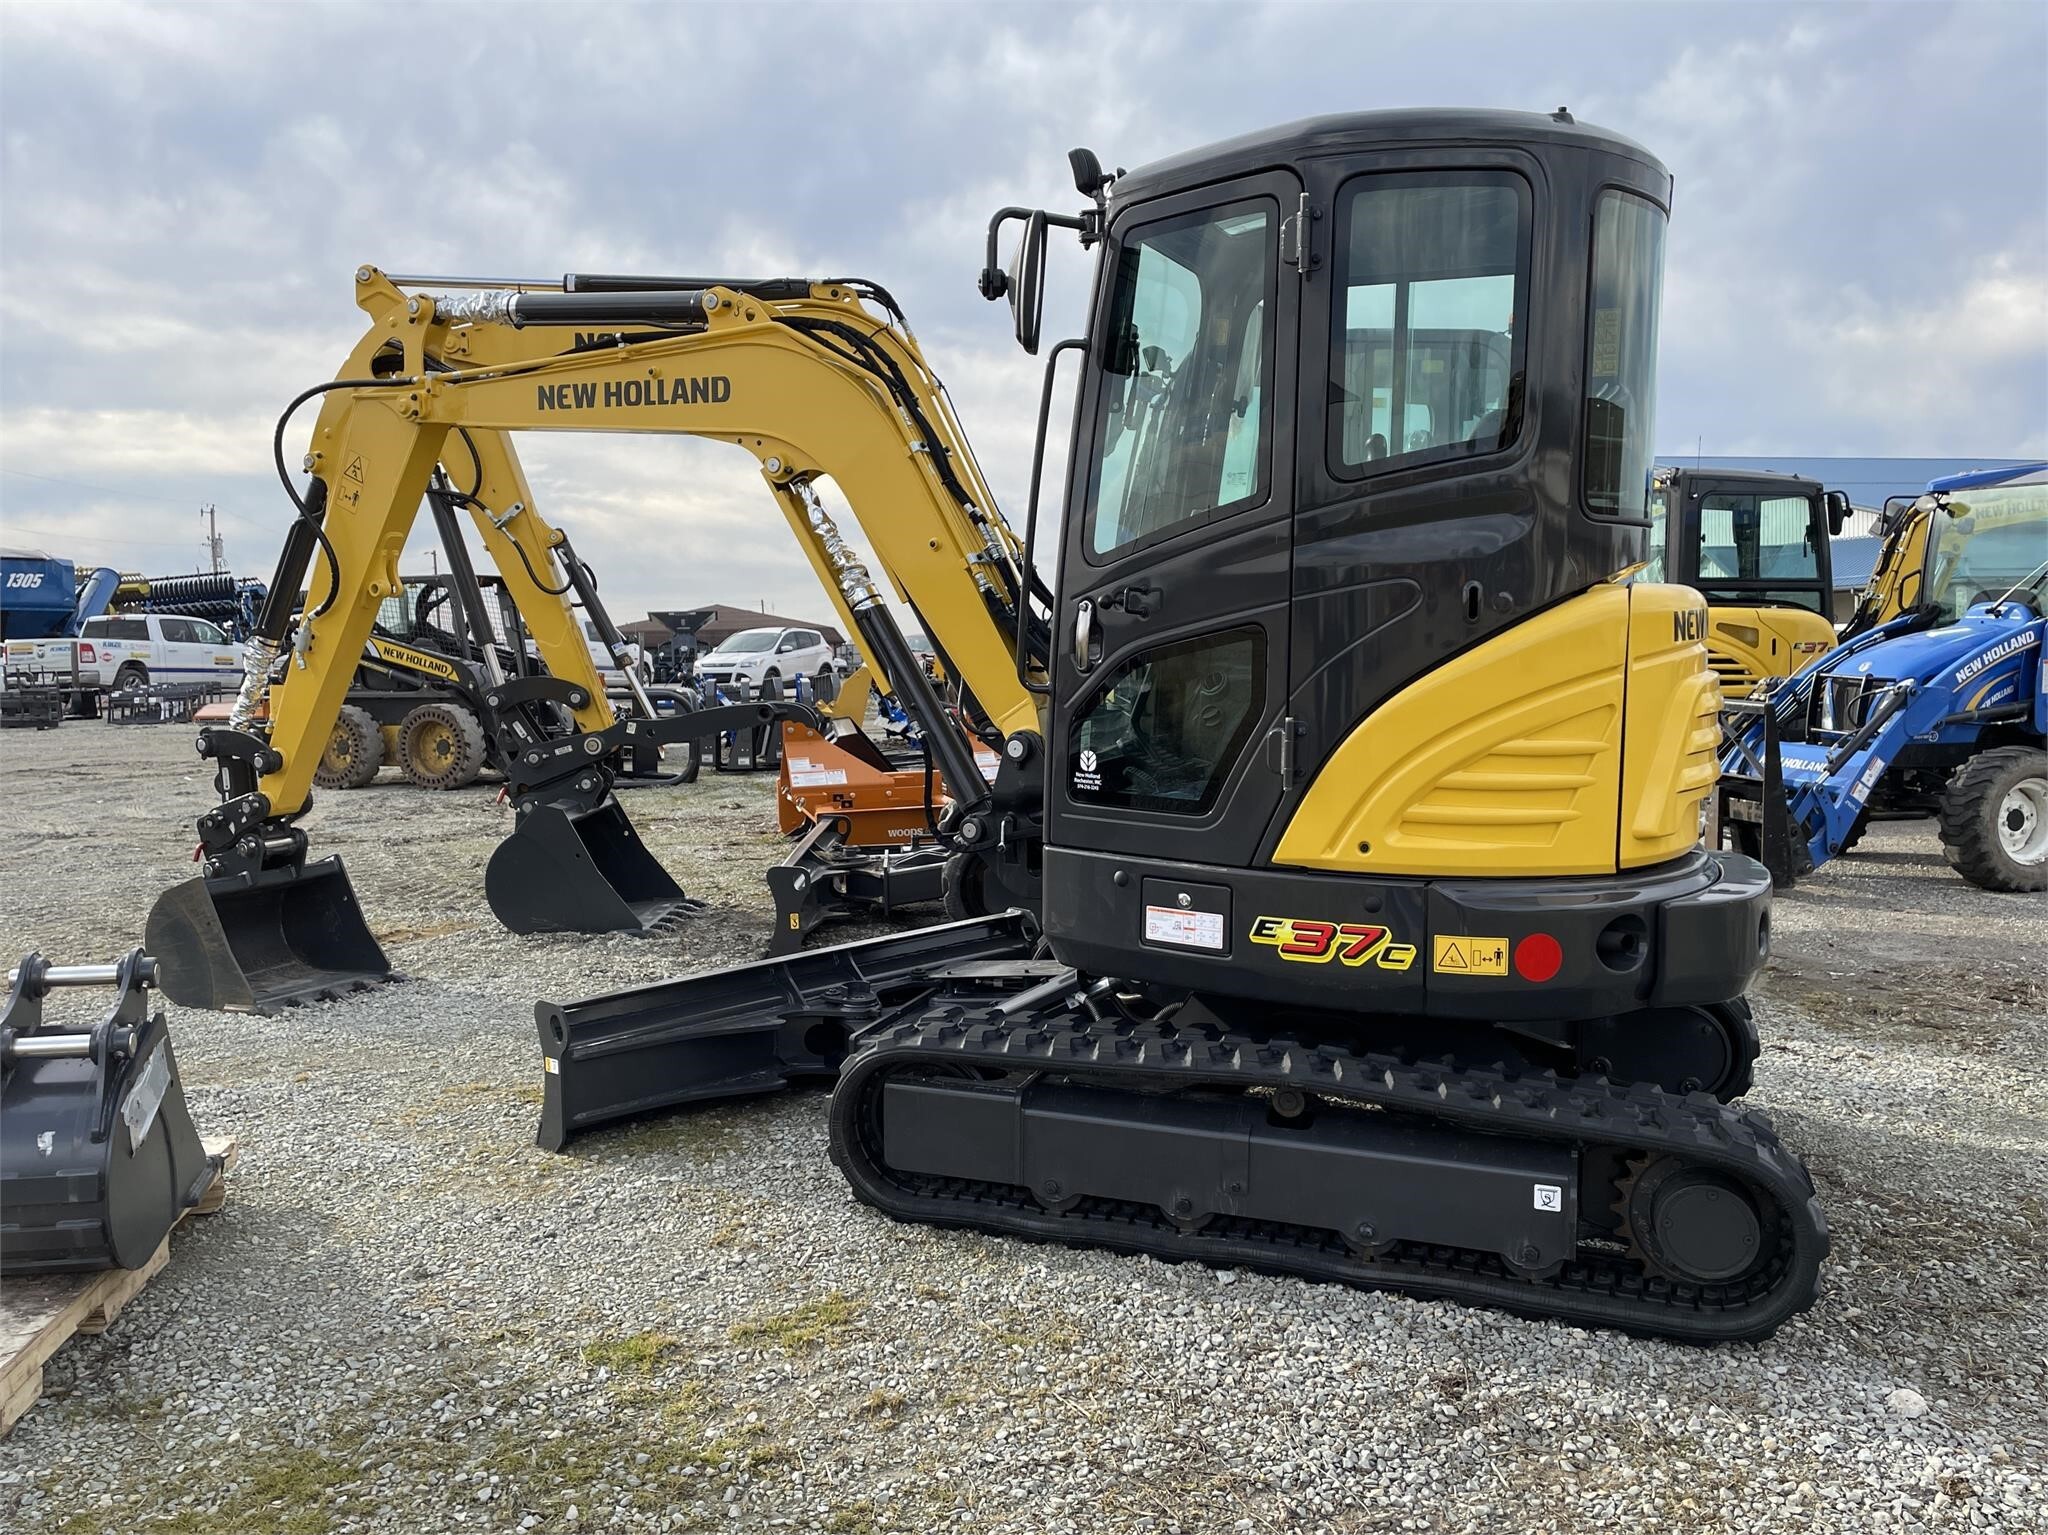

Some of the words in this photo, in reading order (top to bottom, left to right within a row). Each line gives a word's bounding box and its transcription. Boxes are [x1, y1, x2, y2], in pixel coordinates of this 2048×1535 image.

[537, 382, 597, 411] NEW
[604, 376, 731, 408] HOLLAND
[6, 572, 44, 589] 1305
[383, 646, 405, 660] NEW
[406, 653, 448, 674] HOLLAND
[1955, 657, 1983, 684] NEW
[1982, 630, 2036, 665] HOLLAND
[1991, 684, 2014, 705] HOLLAND
